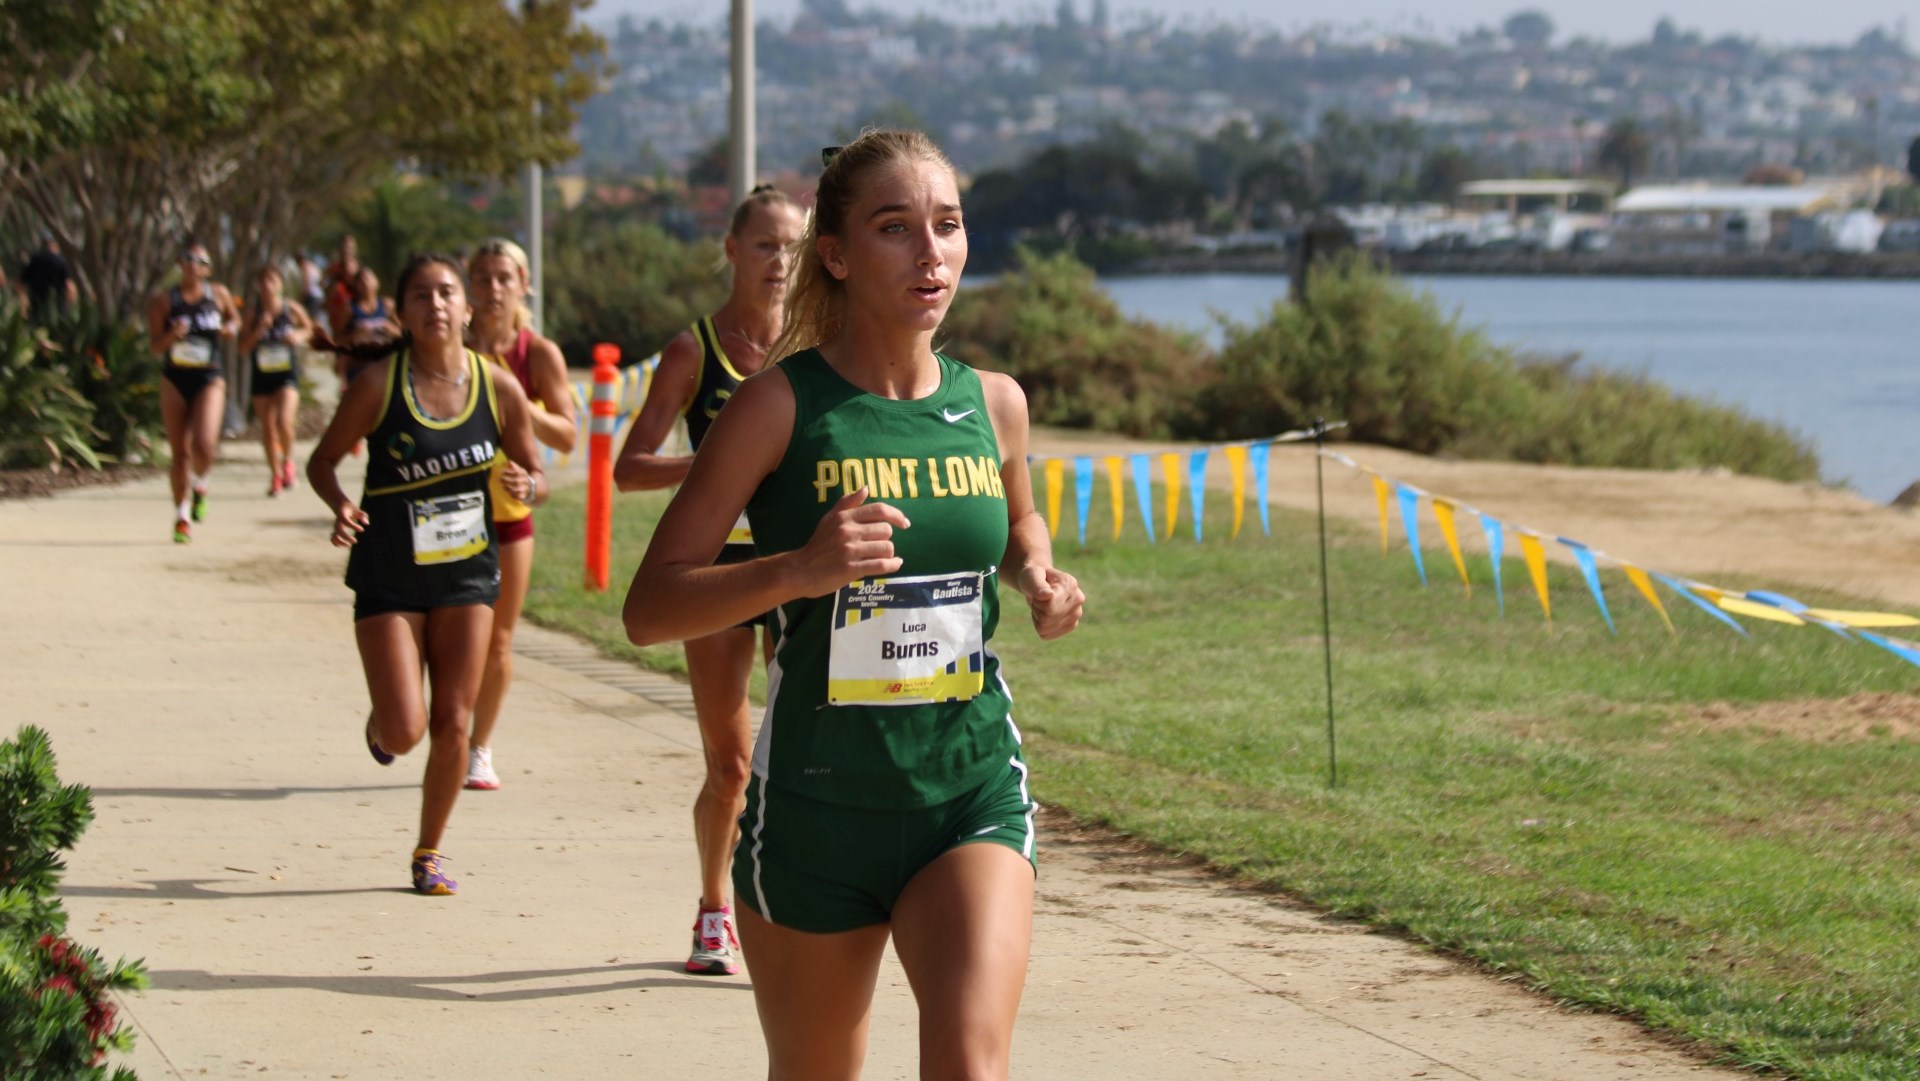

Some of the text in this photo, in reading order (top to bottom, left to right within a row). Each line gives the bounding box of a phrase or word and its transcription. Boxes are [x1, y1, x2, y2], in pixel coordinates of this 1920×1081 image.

[812, 456, 1004, 503] POINT LOMA
[857, 584, 886, 595] 2022
[933, 585, 973, 600] Bautista
[848, 594, 895, 603] Cross Country
[902, 622, 927, 634] Luca
[881, 640, 939, 660] Burns
